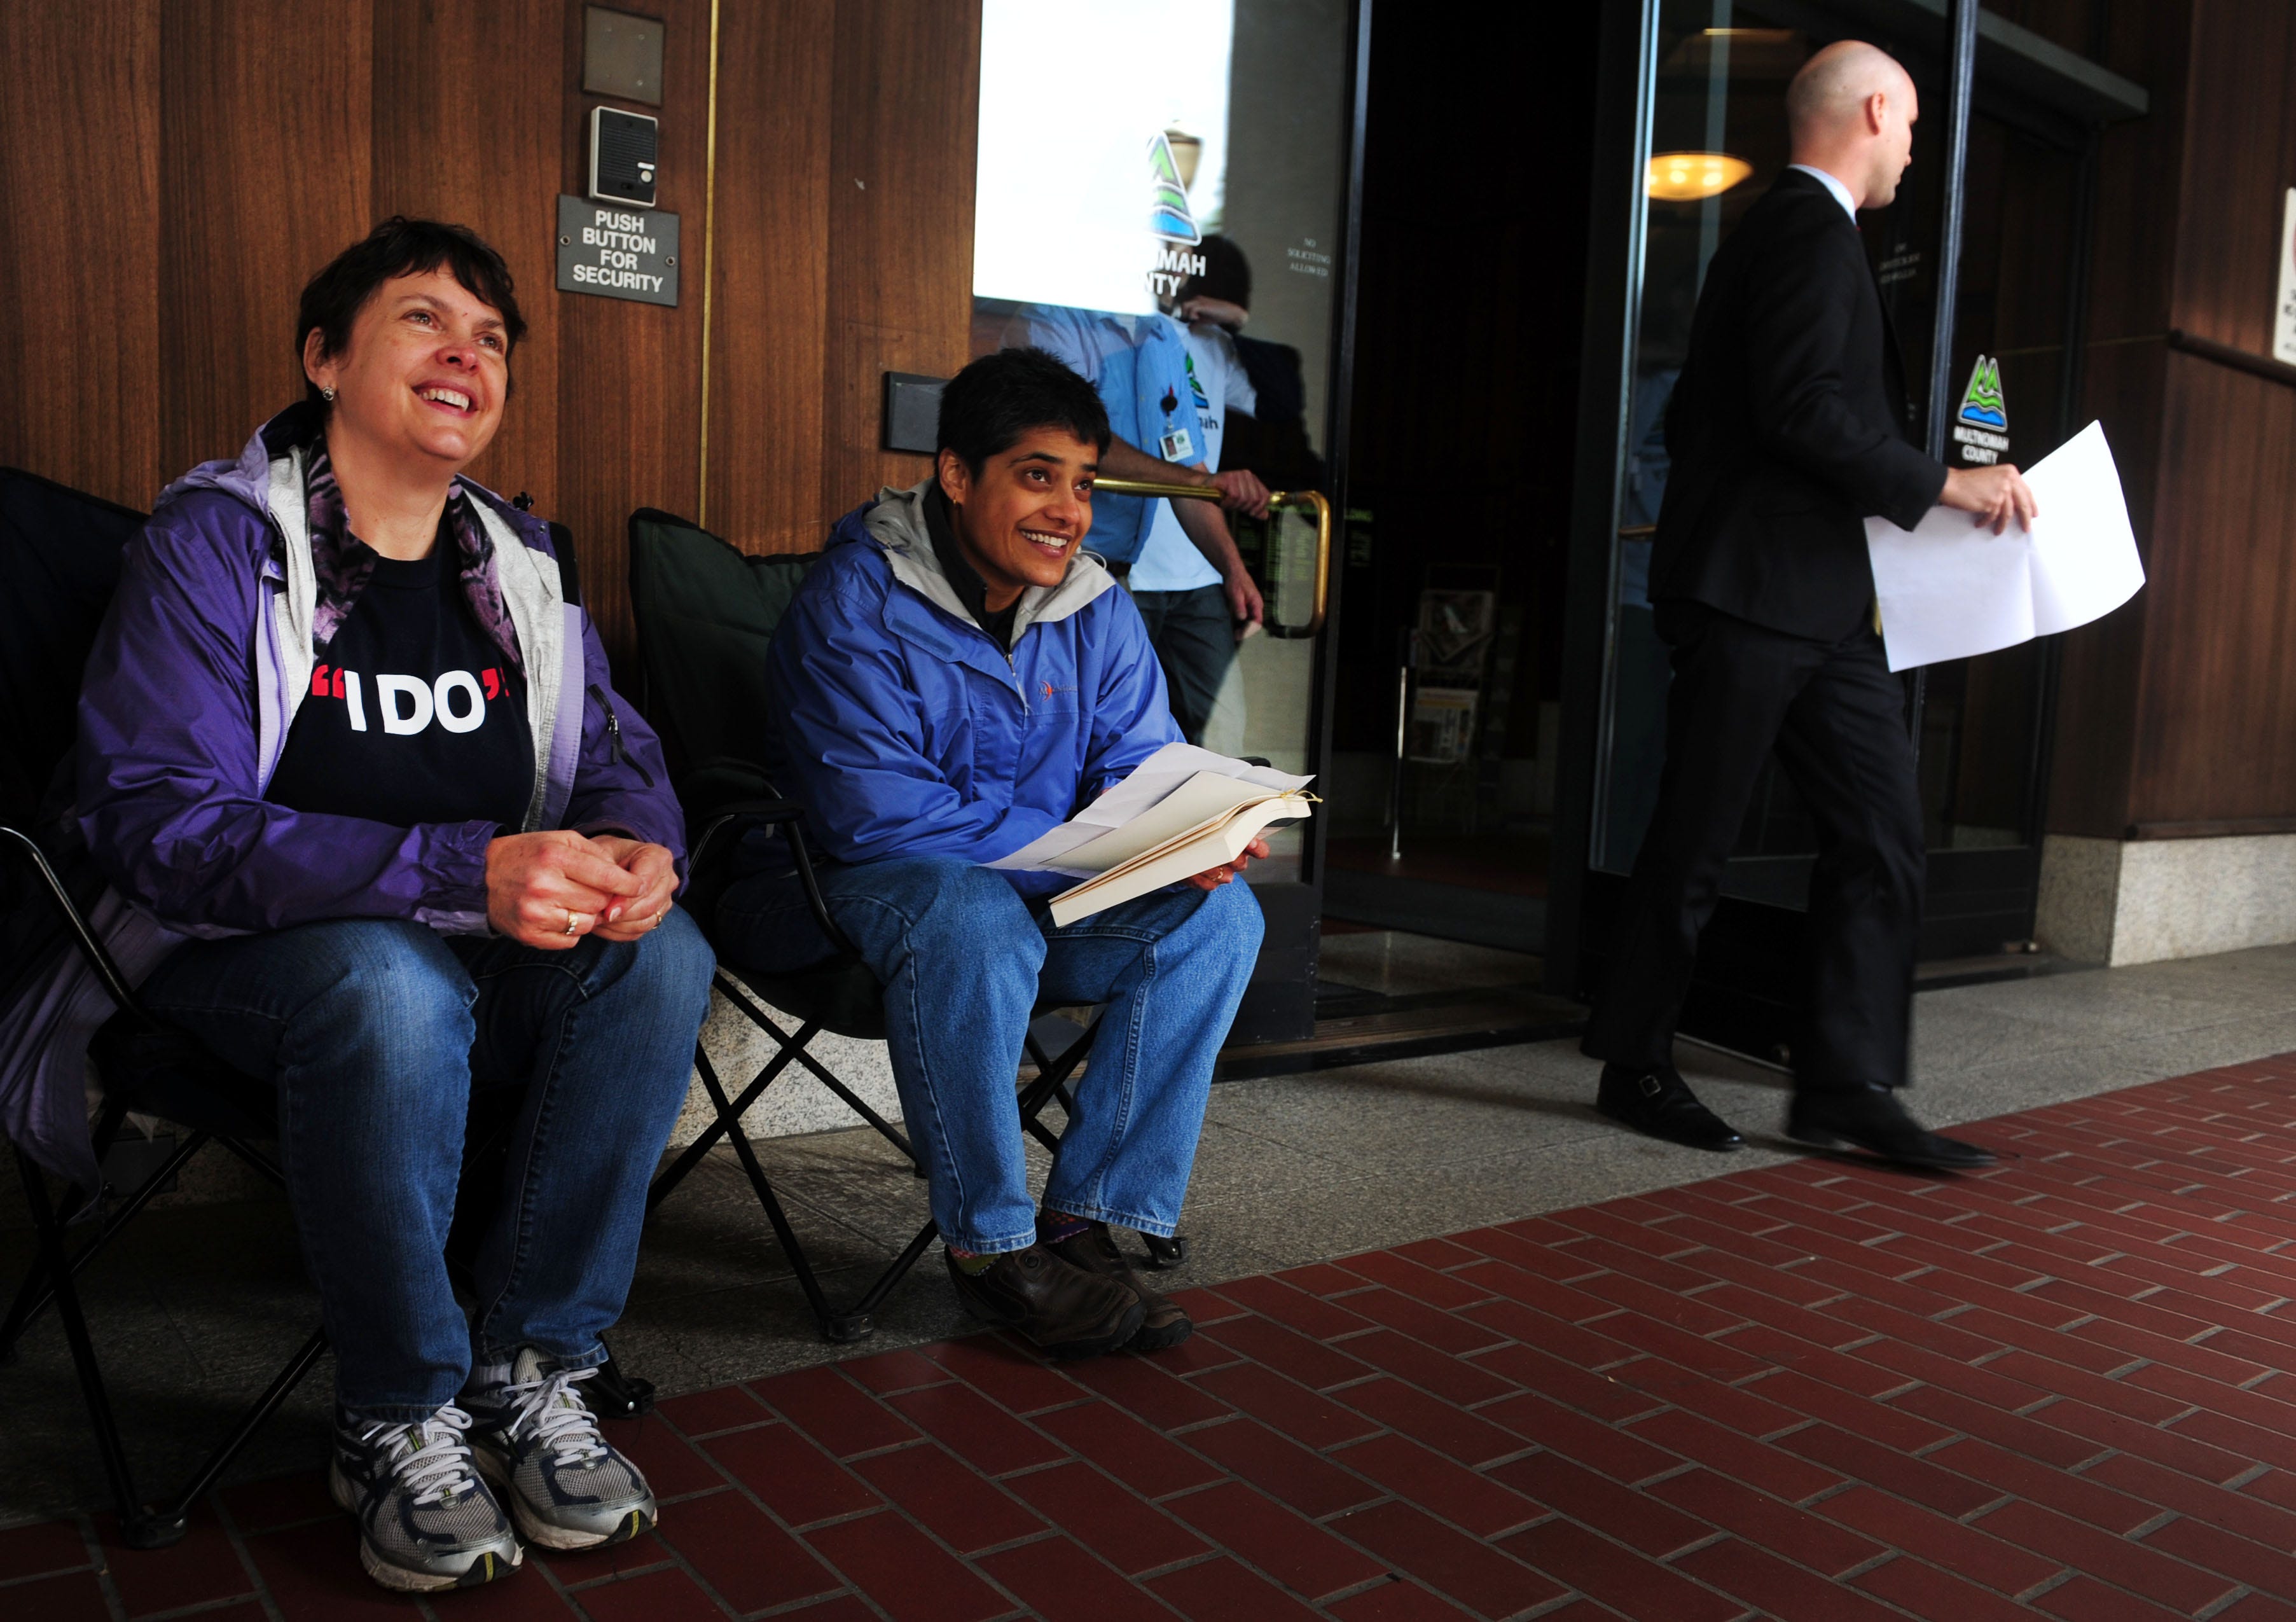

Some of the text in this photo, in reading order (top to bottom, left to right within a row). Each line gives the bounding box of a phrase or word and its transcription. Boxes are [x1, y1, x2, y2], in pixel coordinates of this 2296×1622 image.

[595, 209, 645, 233] PUSH
[582, 226, 656, 254] BUTTON
[600, 249, 638, 270] FOR
[1157, 249, 1207, 277] MAH
[573, 264, 663, 293] SECURITY
